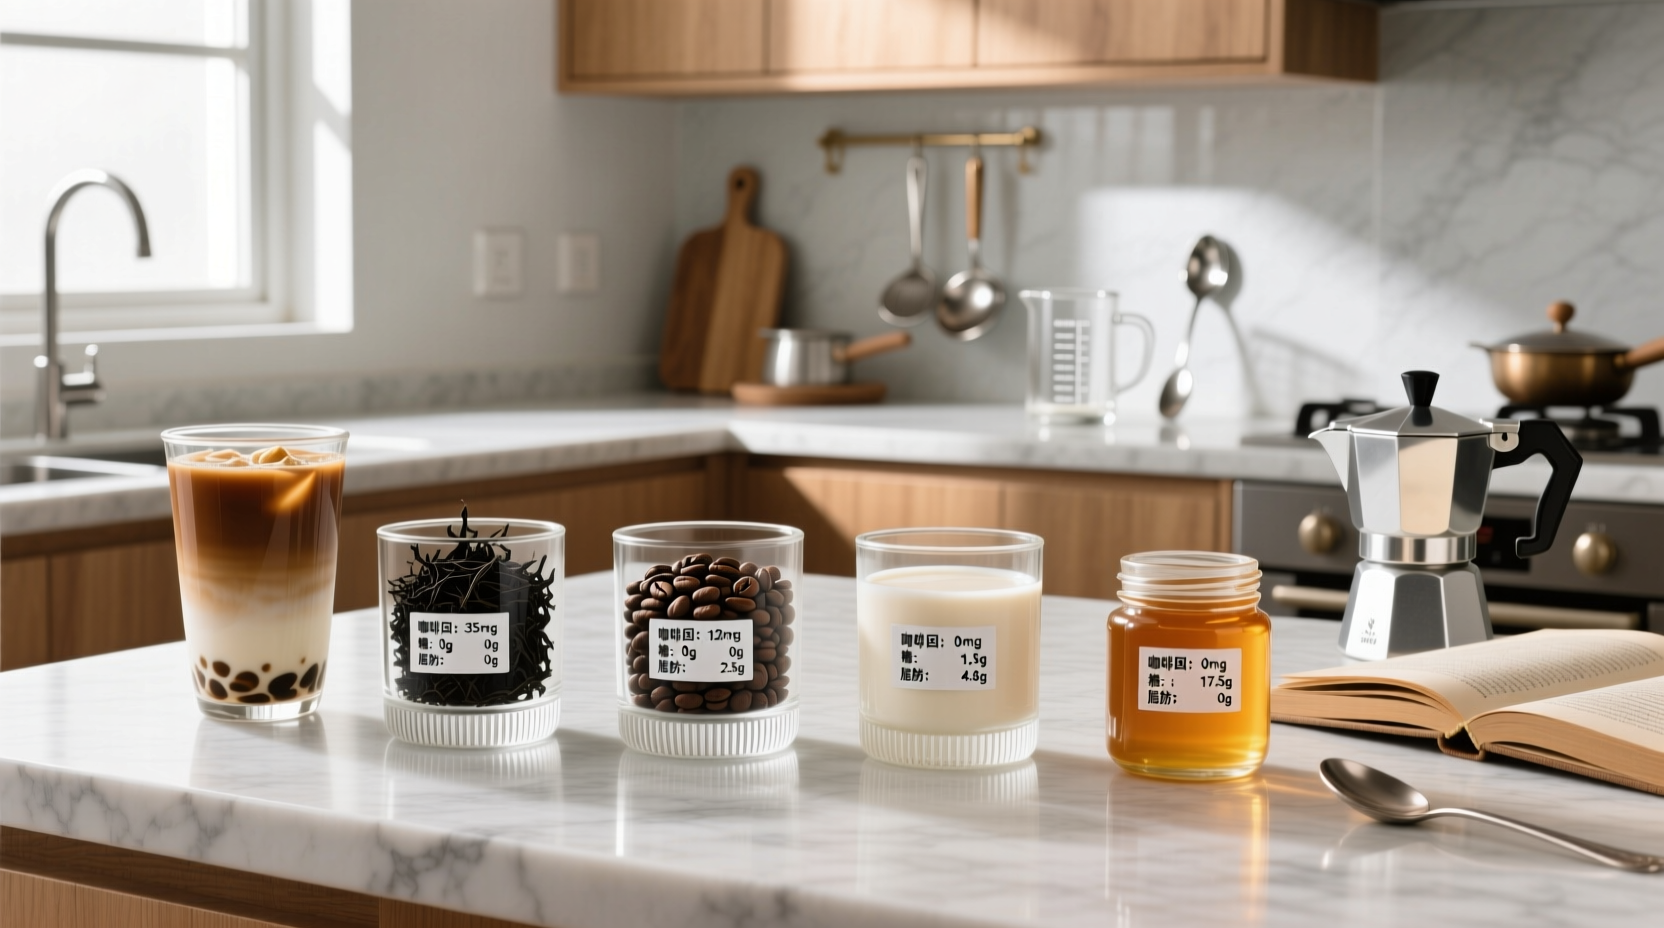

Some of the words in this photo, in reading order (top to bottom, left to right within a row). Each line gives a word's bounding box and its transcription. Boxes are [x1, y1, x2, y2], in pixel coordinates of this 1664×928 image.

[439, 638, 453, 653] 0g
[484, 639, 499, 652] 0g
[954, 635, 982, 650] 0mg
[682, 645, 696, 660] 0g
[729, 646, 743, 660] 0g
[484, 654, 498, 668] 0g
[1201, 657, 1227, 673] 0mg
[1217, 692, 1232, 707] 0g
